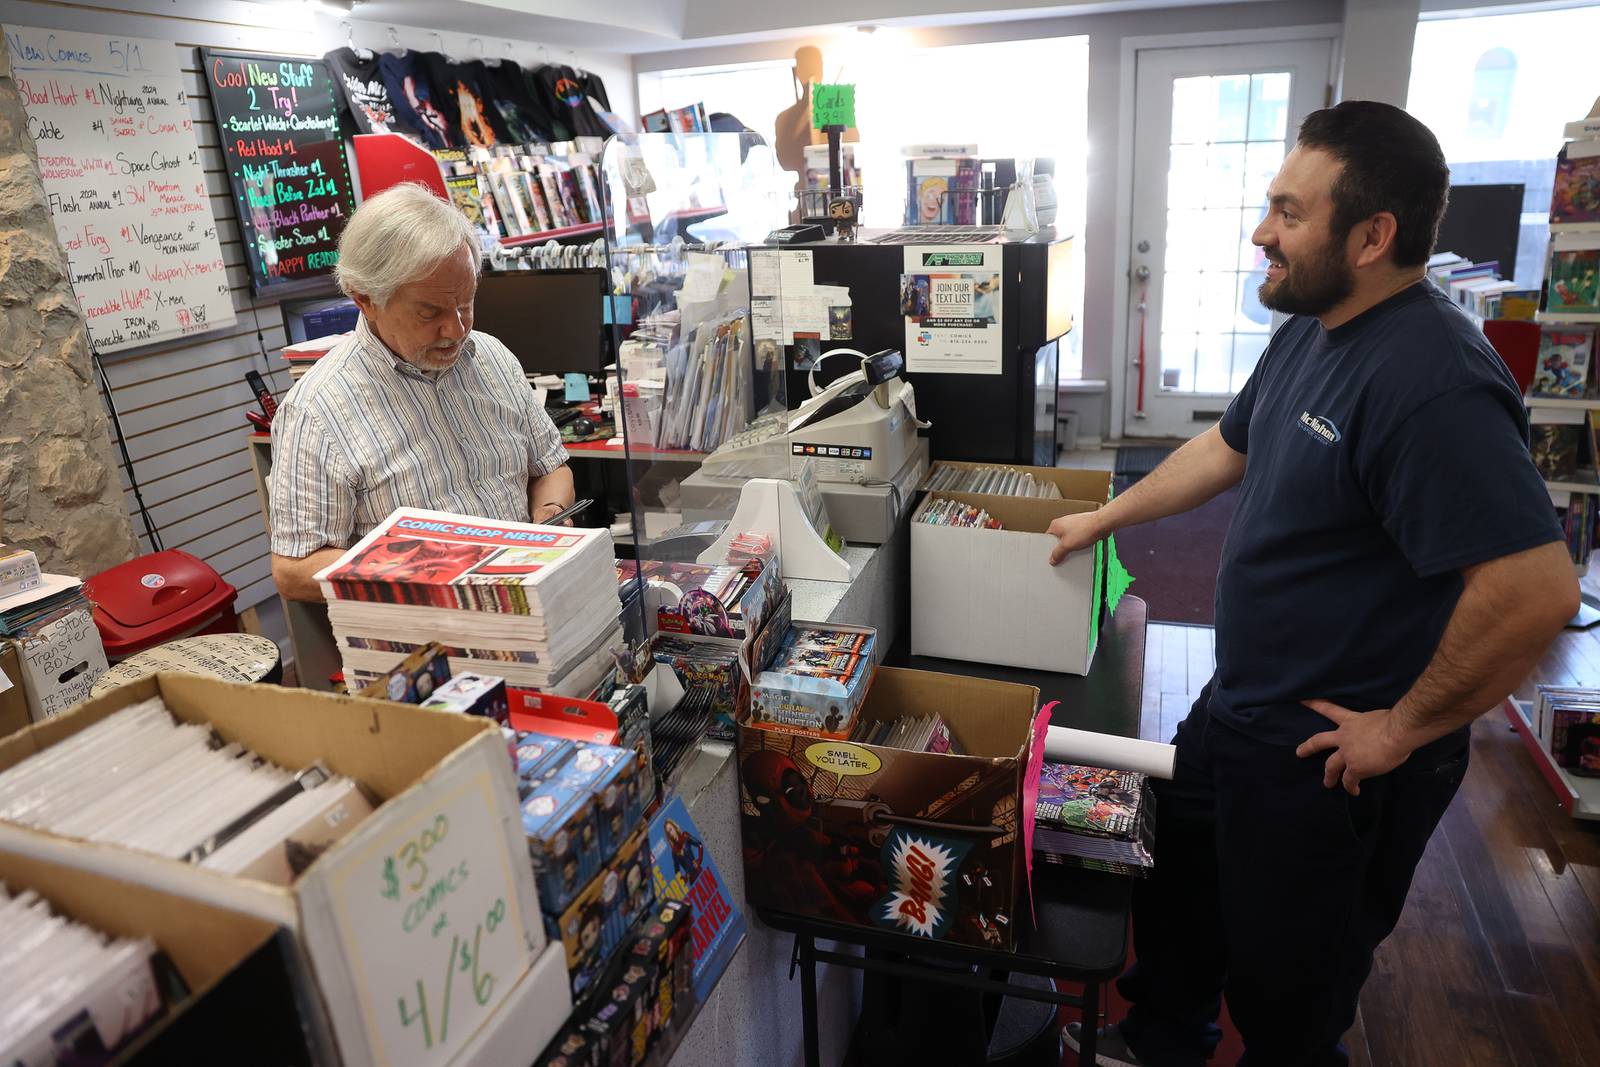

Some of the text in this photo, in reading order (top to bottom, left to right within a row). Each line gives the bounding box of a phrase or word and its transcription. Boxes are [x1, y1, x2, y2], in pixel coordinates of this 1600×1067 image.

[7, 34, 151, 72] New Comics 5/1
[213, 58, 313, 87] Cool New Stuff
[17, 79, 101, 107] Blood Hunt #1
[177, 90, 187, 106] #1
[246, 87, 299, 117] 2 Try!
[25, 115, 105, 140] Cable #4
[229, 115, 261, 132] Scarlet
[237, 138, 297, 157] Red Hood #1
[116, 150, 200, 177] Space Ghost #1
[243, 164, 269, 187] Night
[311, 158, 326, 176] #1
[127, 184, 145, 205] SW
[305, 178, 326, 199] Zod
[326, 177, 339, 196] #1
[48, 192, 82, 216] Flash
[80, 190, 97, 199] 2024
[112, 190, 125, 206] #1
[330, 202, 343, 217] #1
[85, 223, 110, 254] Fury
[121, 226, 134, 243] #1
[131, 223, 184, 250] Vengeance
[292, 228, 316, 246] Sons
[317, 226, 331, 241] #1
[68, 261, 105, 284] Immortal
[103, 257, 126, 279] Thor
[936, 283, 970, 293] JOIN OUR
[936, 293, 971, 304] TEXT LIST
[124, 317, 146, 330] IRON
[130, 329, 151, 341] MAN
[398, 519, 558, 543] COMIC SHOP NEWS
[26, 626, 91, 667] Transfer
[777, 714, 822, 729] JUNCTION
[790, 729, 821, 737] BOOSTERS
[815, 755, 870, 769] YOU LATER.
[827, 750, 858, 760] SMELL
[899, 844, 937, 925] BANG!
